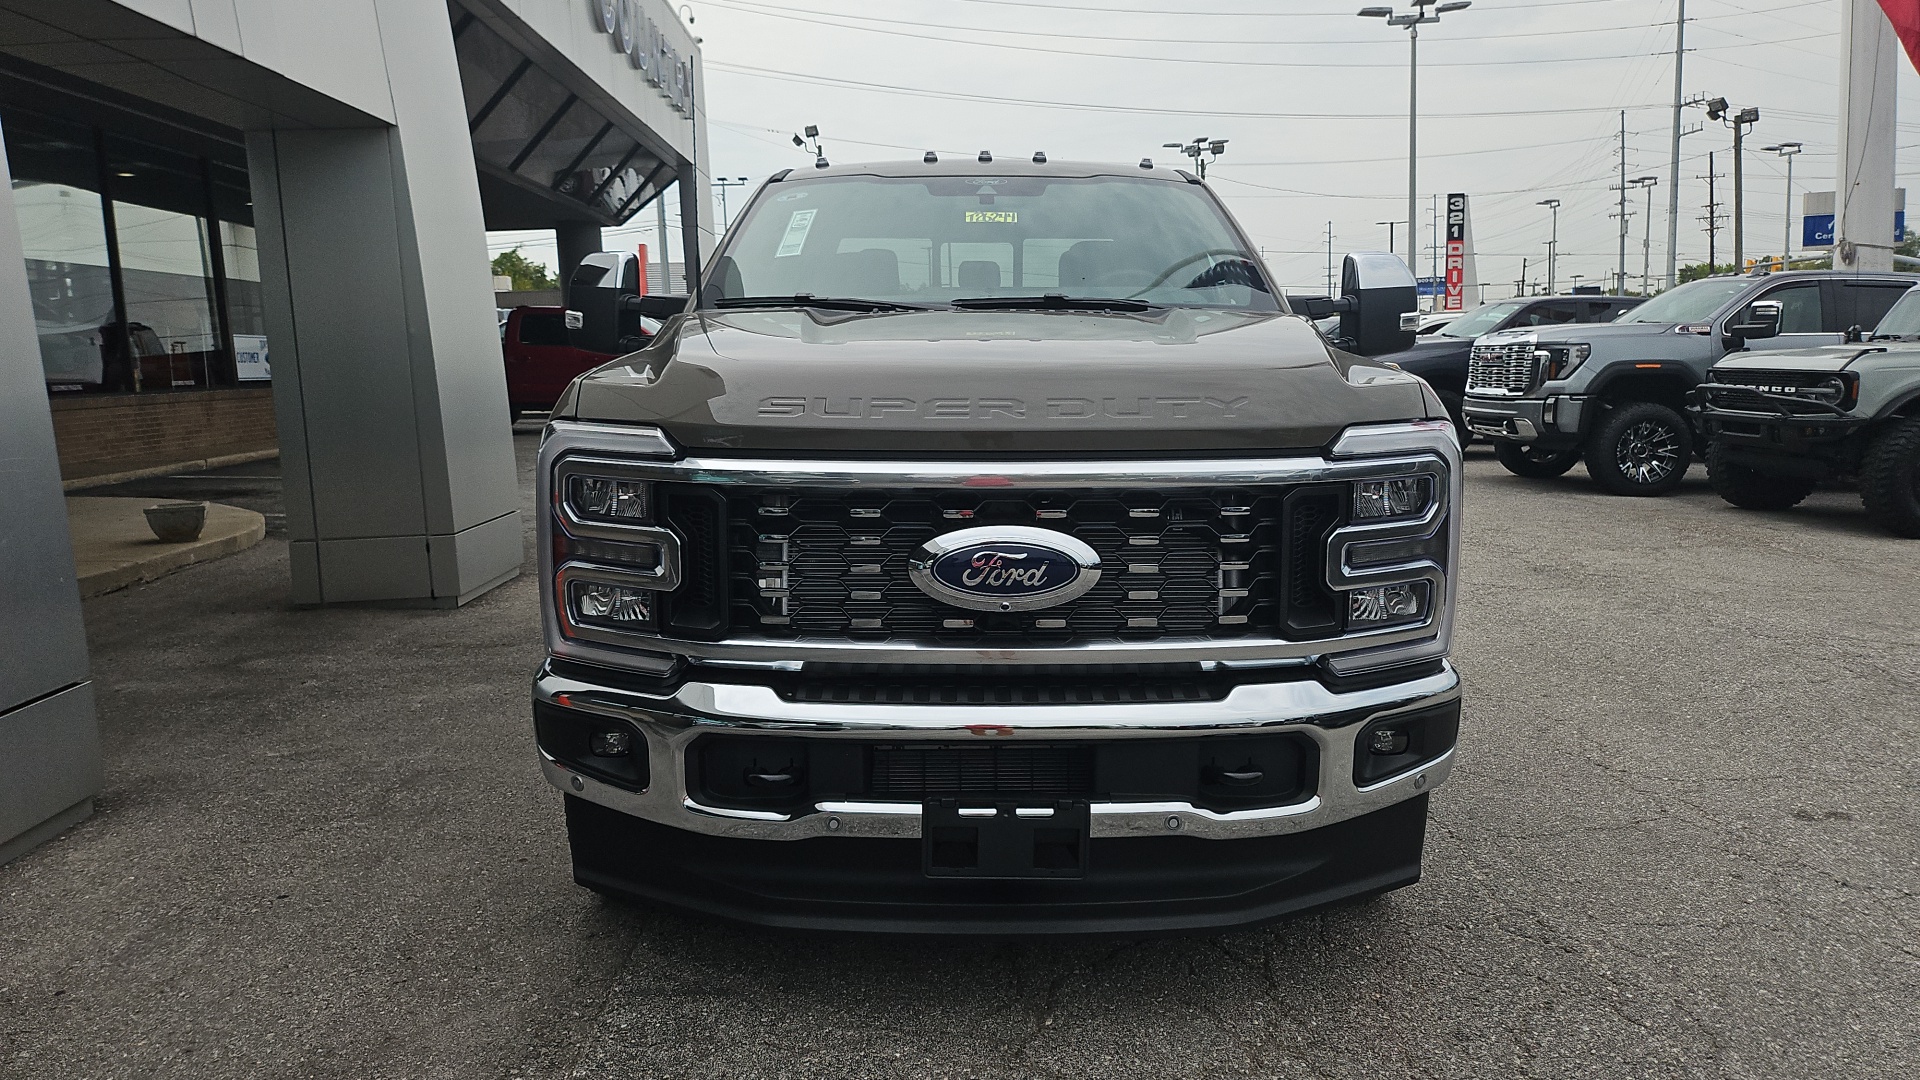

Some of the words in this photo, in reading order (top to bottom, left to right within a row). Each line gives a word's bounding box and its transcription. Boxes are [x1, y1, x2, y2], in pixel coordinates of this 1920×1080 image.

[1449, 197, 1464, 238] 321
[1447, 243, 1464, 309] DRIVE
[757, 396, 1027, 419] SUPER
[1047, 396, 1250, 418] DUTY
[961, 550, 1049, 588] Ford
